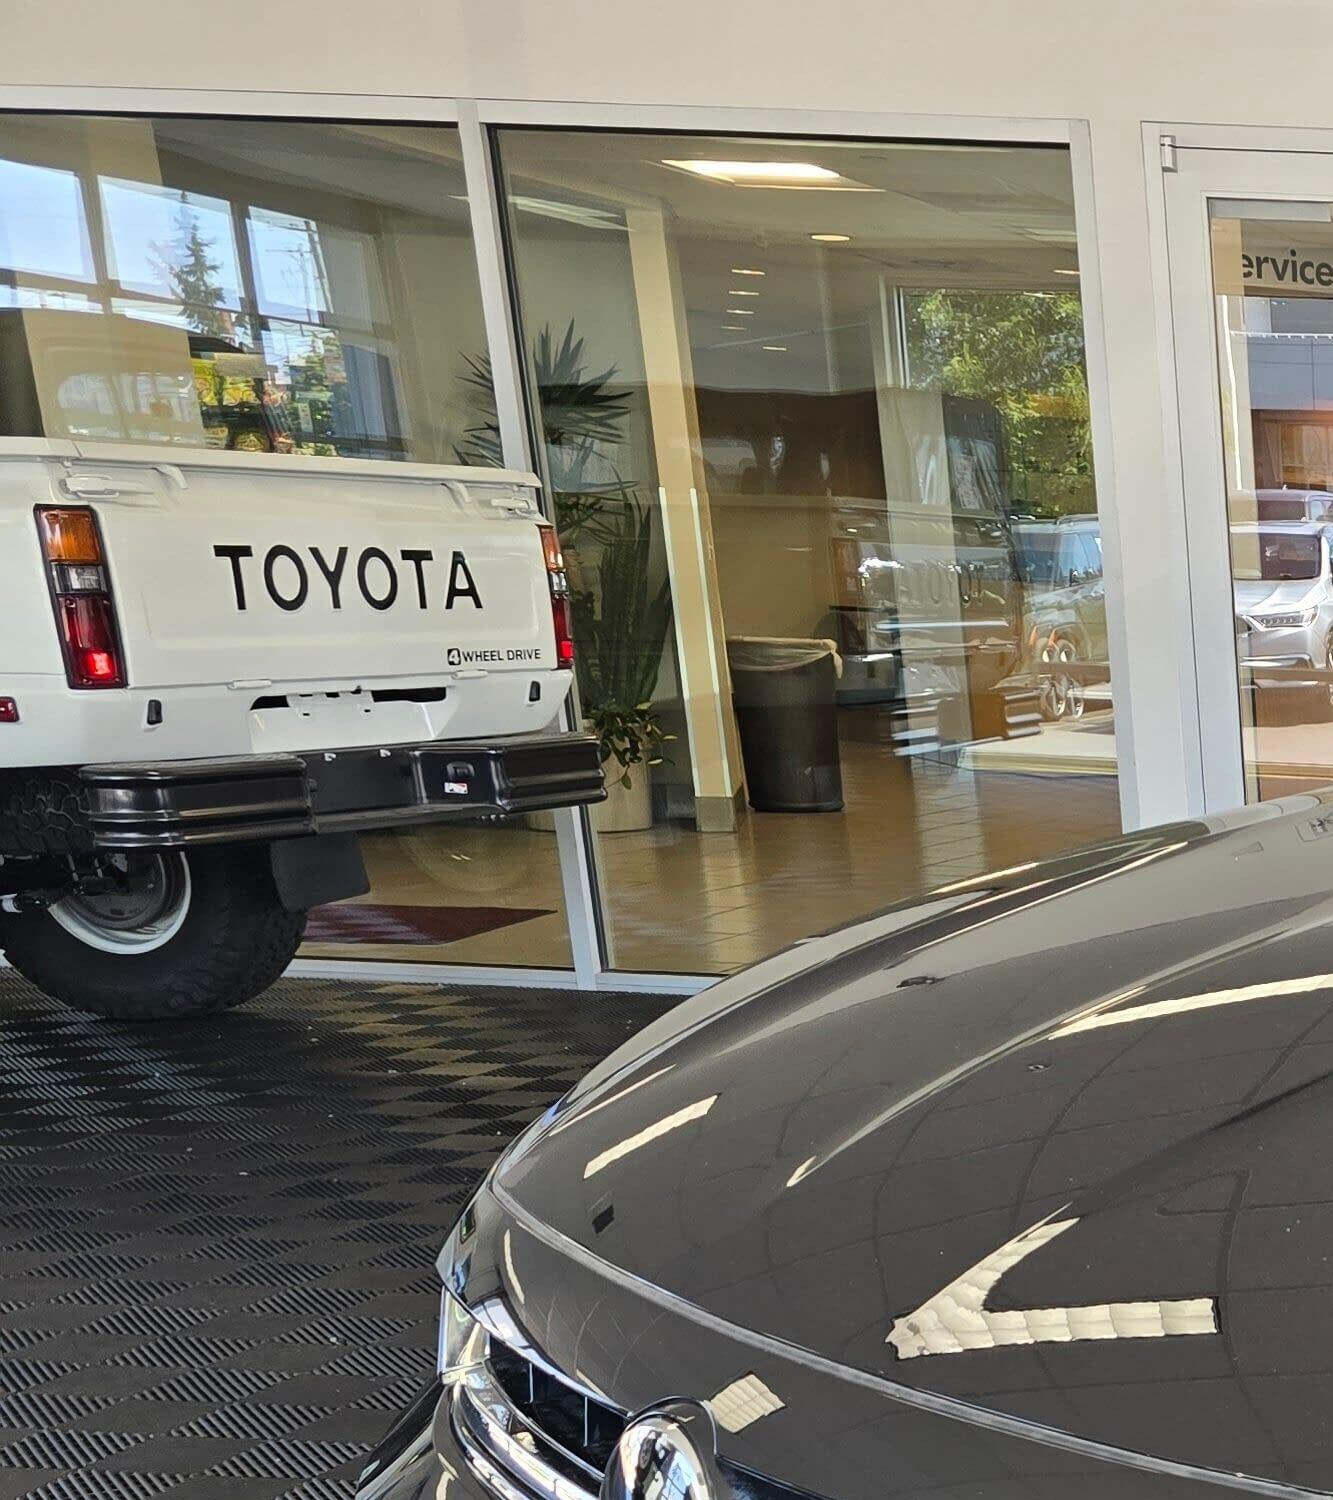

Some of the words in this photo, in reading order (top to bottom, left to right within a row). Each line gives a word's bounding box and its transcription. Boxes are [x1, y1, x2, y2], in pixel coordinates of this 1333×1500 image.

[213, 544, 483, 611] TOYOTA
[461, 650, 504, 662] WHEEL
[506, 648, 541, 661] DRIVE
